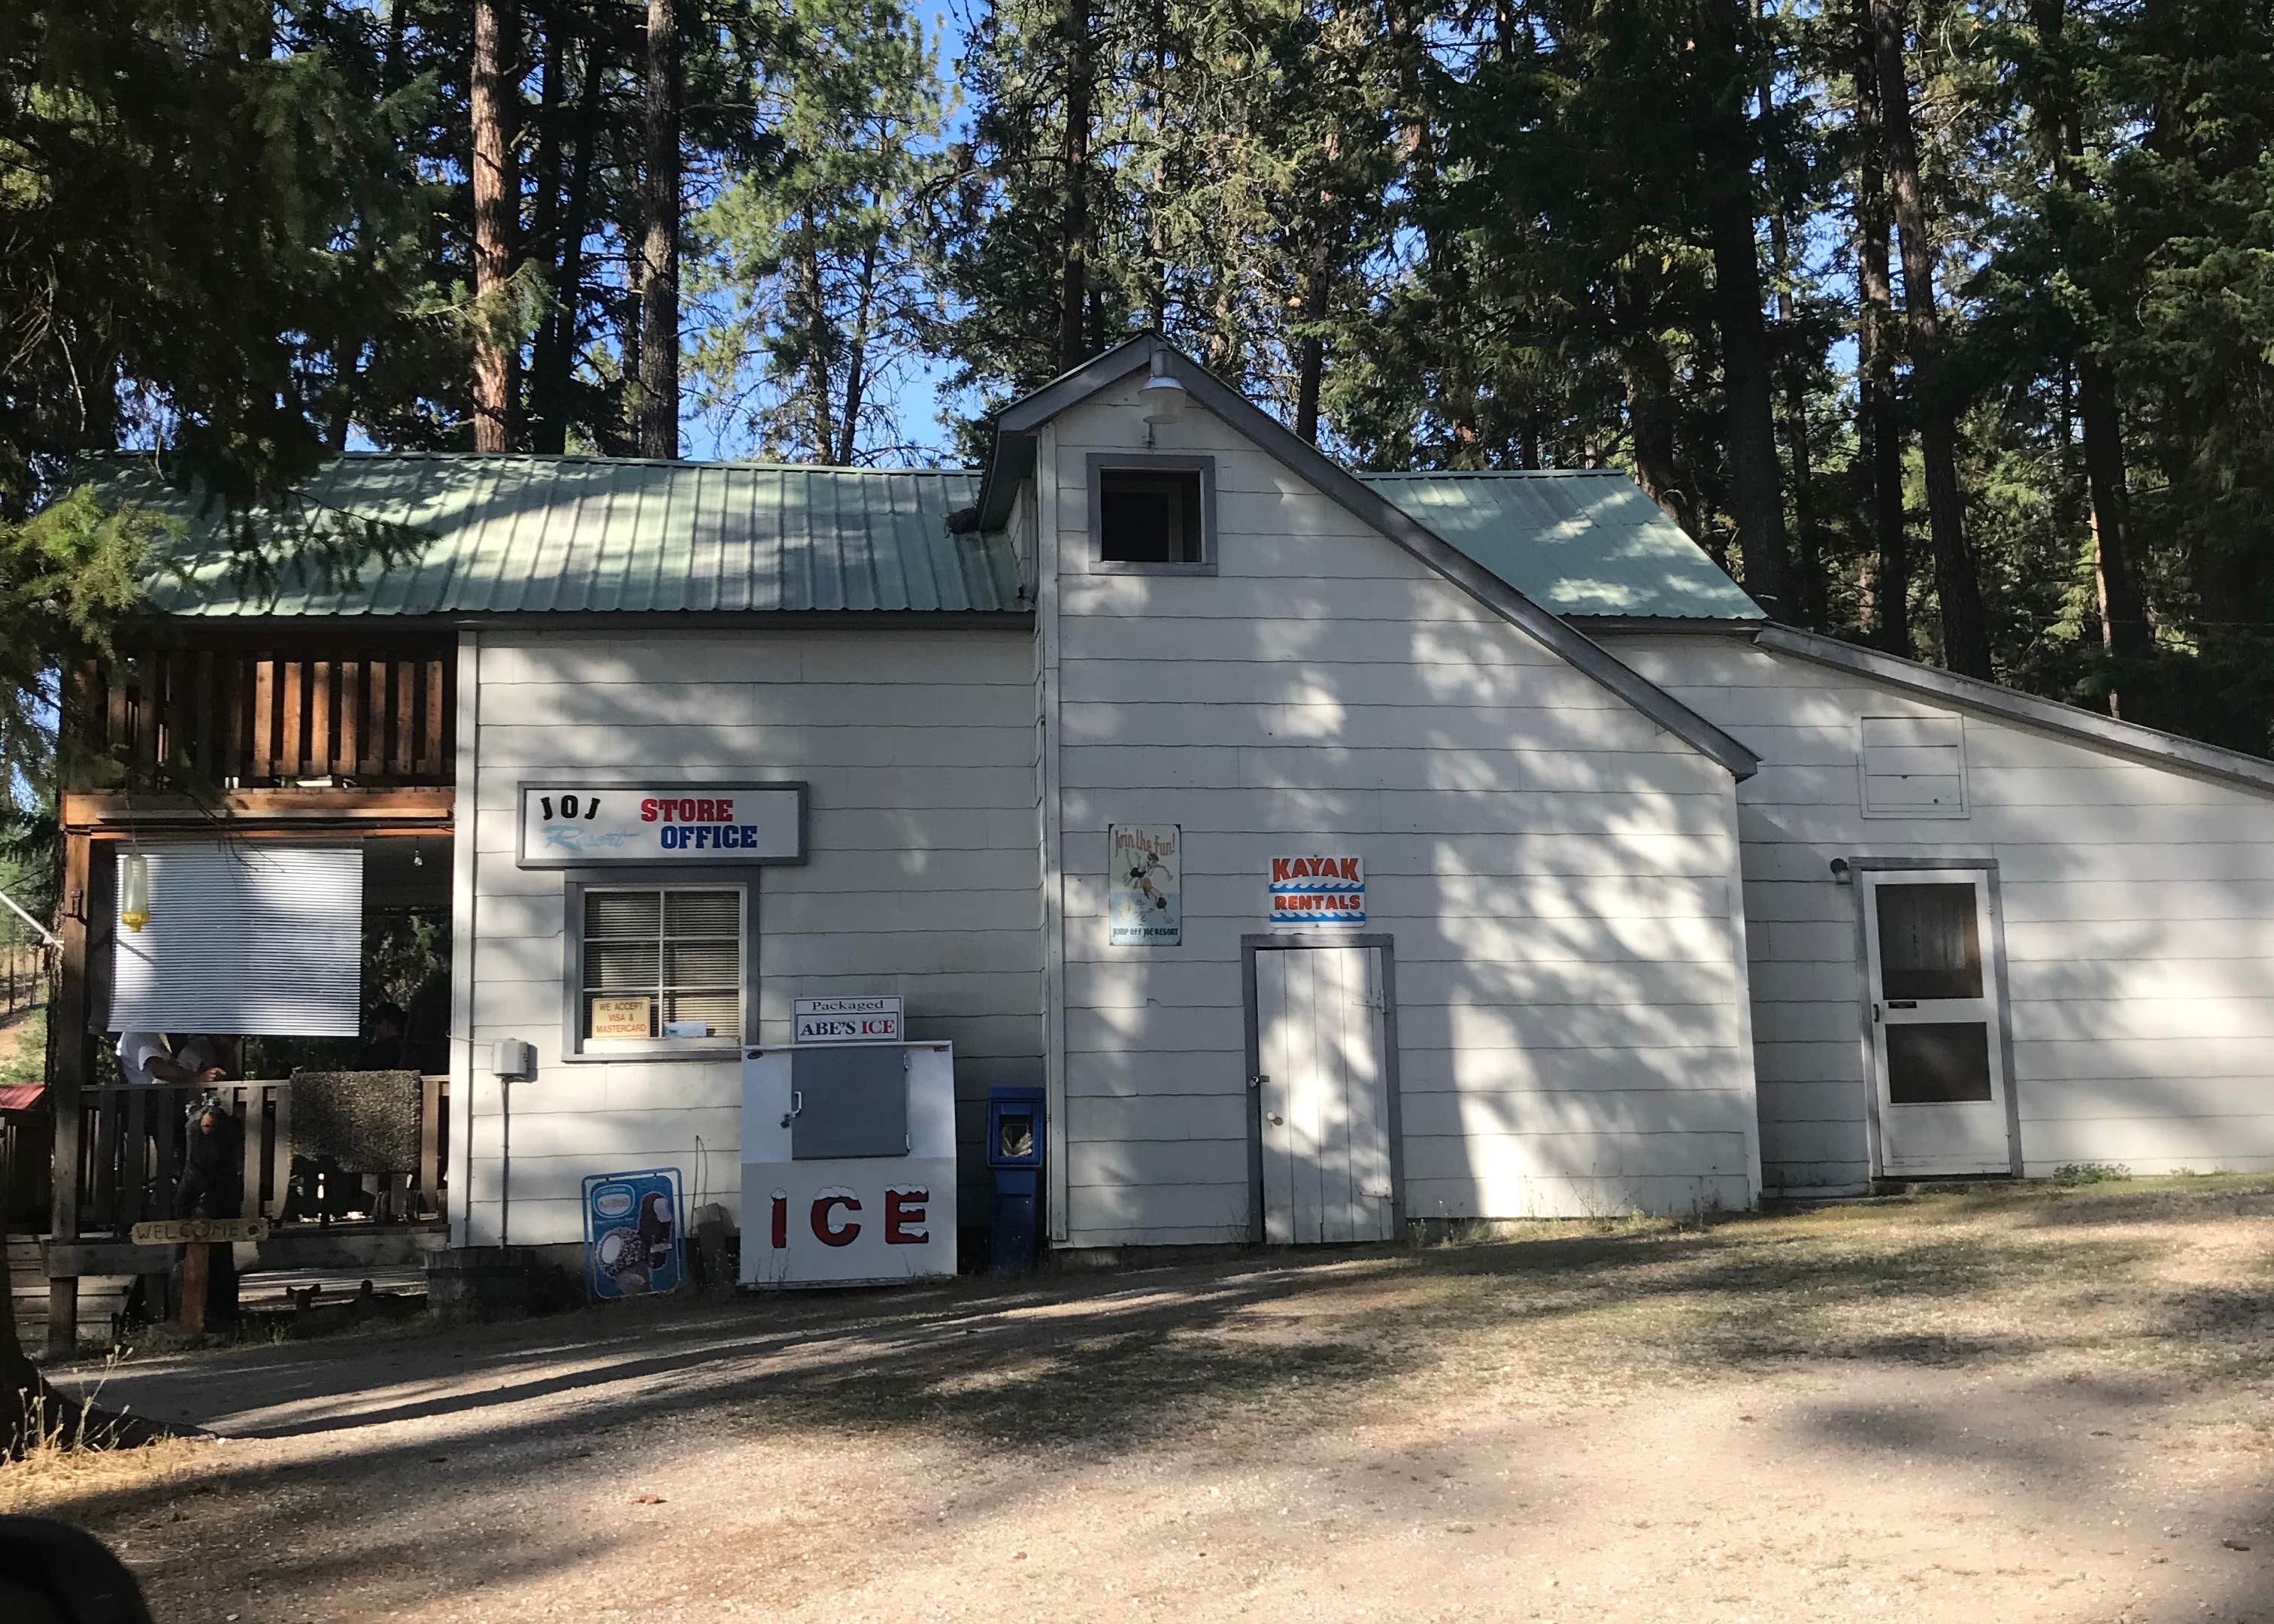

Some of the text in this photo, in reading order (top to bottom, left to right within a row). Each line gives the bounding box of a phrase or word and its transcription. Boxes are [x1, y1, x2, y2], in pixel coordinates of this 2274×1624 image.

[641, 798, 734, 823] STORE
[661, 826, 757, 850] OFFICE
[1114, 828, 1135, 858] Join
[1136, 829, 1153, 852] the
[1272, 858, 1360, 883] KAYAK
[1275, 895, 1360, 910] RENTALS
[1143, 928, 1154, 938] JOE
[614, 1001, 644, 1010] ACCEPT
[812, 1000, 884, 1011] Packaged
[608, 1013, 626, 1022] VISA
[596, 1024, 646, 1032] MASTERCARD
[800, 1019, 895, 1035] ABE'S ICE
[771, 1183, 929, 1249] ICE
[136, 1221, 238, 1240] WELCOME
